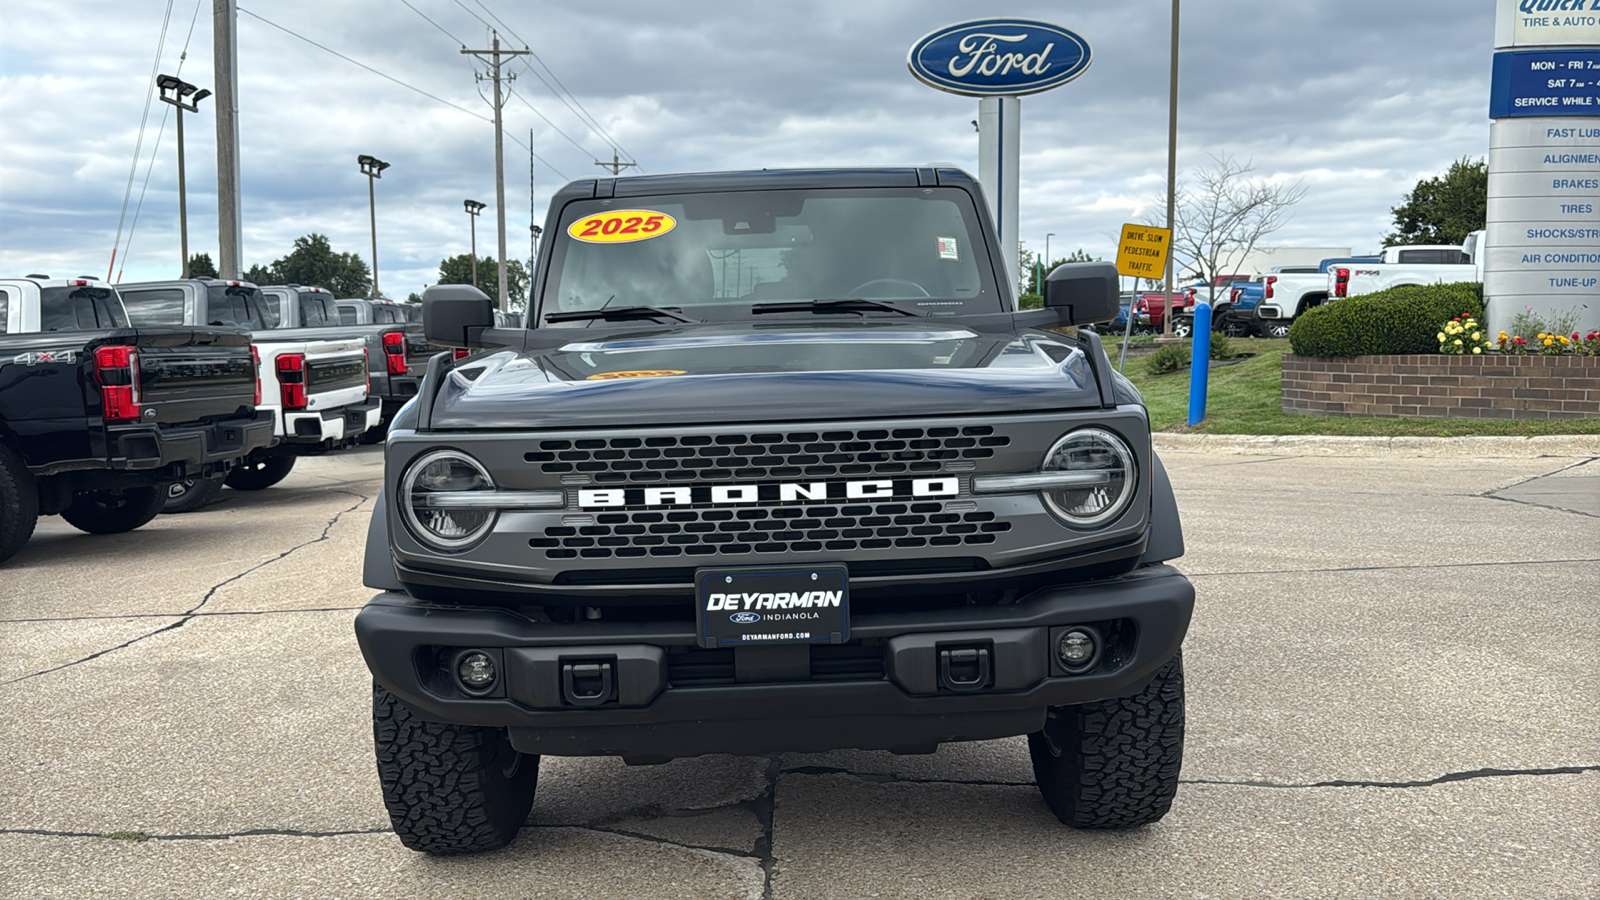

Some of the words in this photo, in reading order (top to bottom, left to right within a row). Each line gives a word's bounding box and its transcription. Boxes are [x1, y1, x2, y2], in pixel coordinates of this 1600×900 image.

[1522, 17, 1550, 27] TIRE
[1552, 16, 1561, 27] &
[1563, 16, 1595, 26] AUTO
[948, 33, 1055, 78] Ford
[1531, 61, 1555, 71] MON
[1568, 60, 1584, 70] FRI
[1547, 79, 1567, 88] SAT
[1514, 97, 1559, 107] SERVICE
[1562, 96, 1593, 106] WHILE
[1547, 128, 1576, 138] FAST
[1552, 179, 1599, 189] BRAKES
[1560, 204, 1593, 214] TIRES
[579, 216, 665, 237] 2025
[1127, 231, 1145, 241] DRIVE
[1147, 233, 1163, 243] SLOW
[1526, 228, 1600, 239] SHOCKS/STR
[1124, 245, 1160, 257] PEDESTRIAN
[1521, 254, 1541, 263] AIR
[1128, 261, 1153, 272] TRAFFIC
[1549, 278, 1597, 287] TUNE-UP
[578, 477, 960, 507] BRONCO
[706, 590, 843, 611] DEYARMAN
[735, 612, 755, 622] Ford
[763, 612, 820, 621] INDIANOLA
[742, 632, 810, 641] DEYARMANFORD.COM
